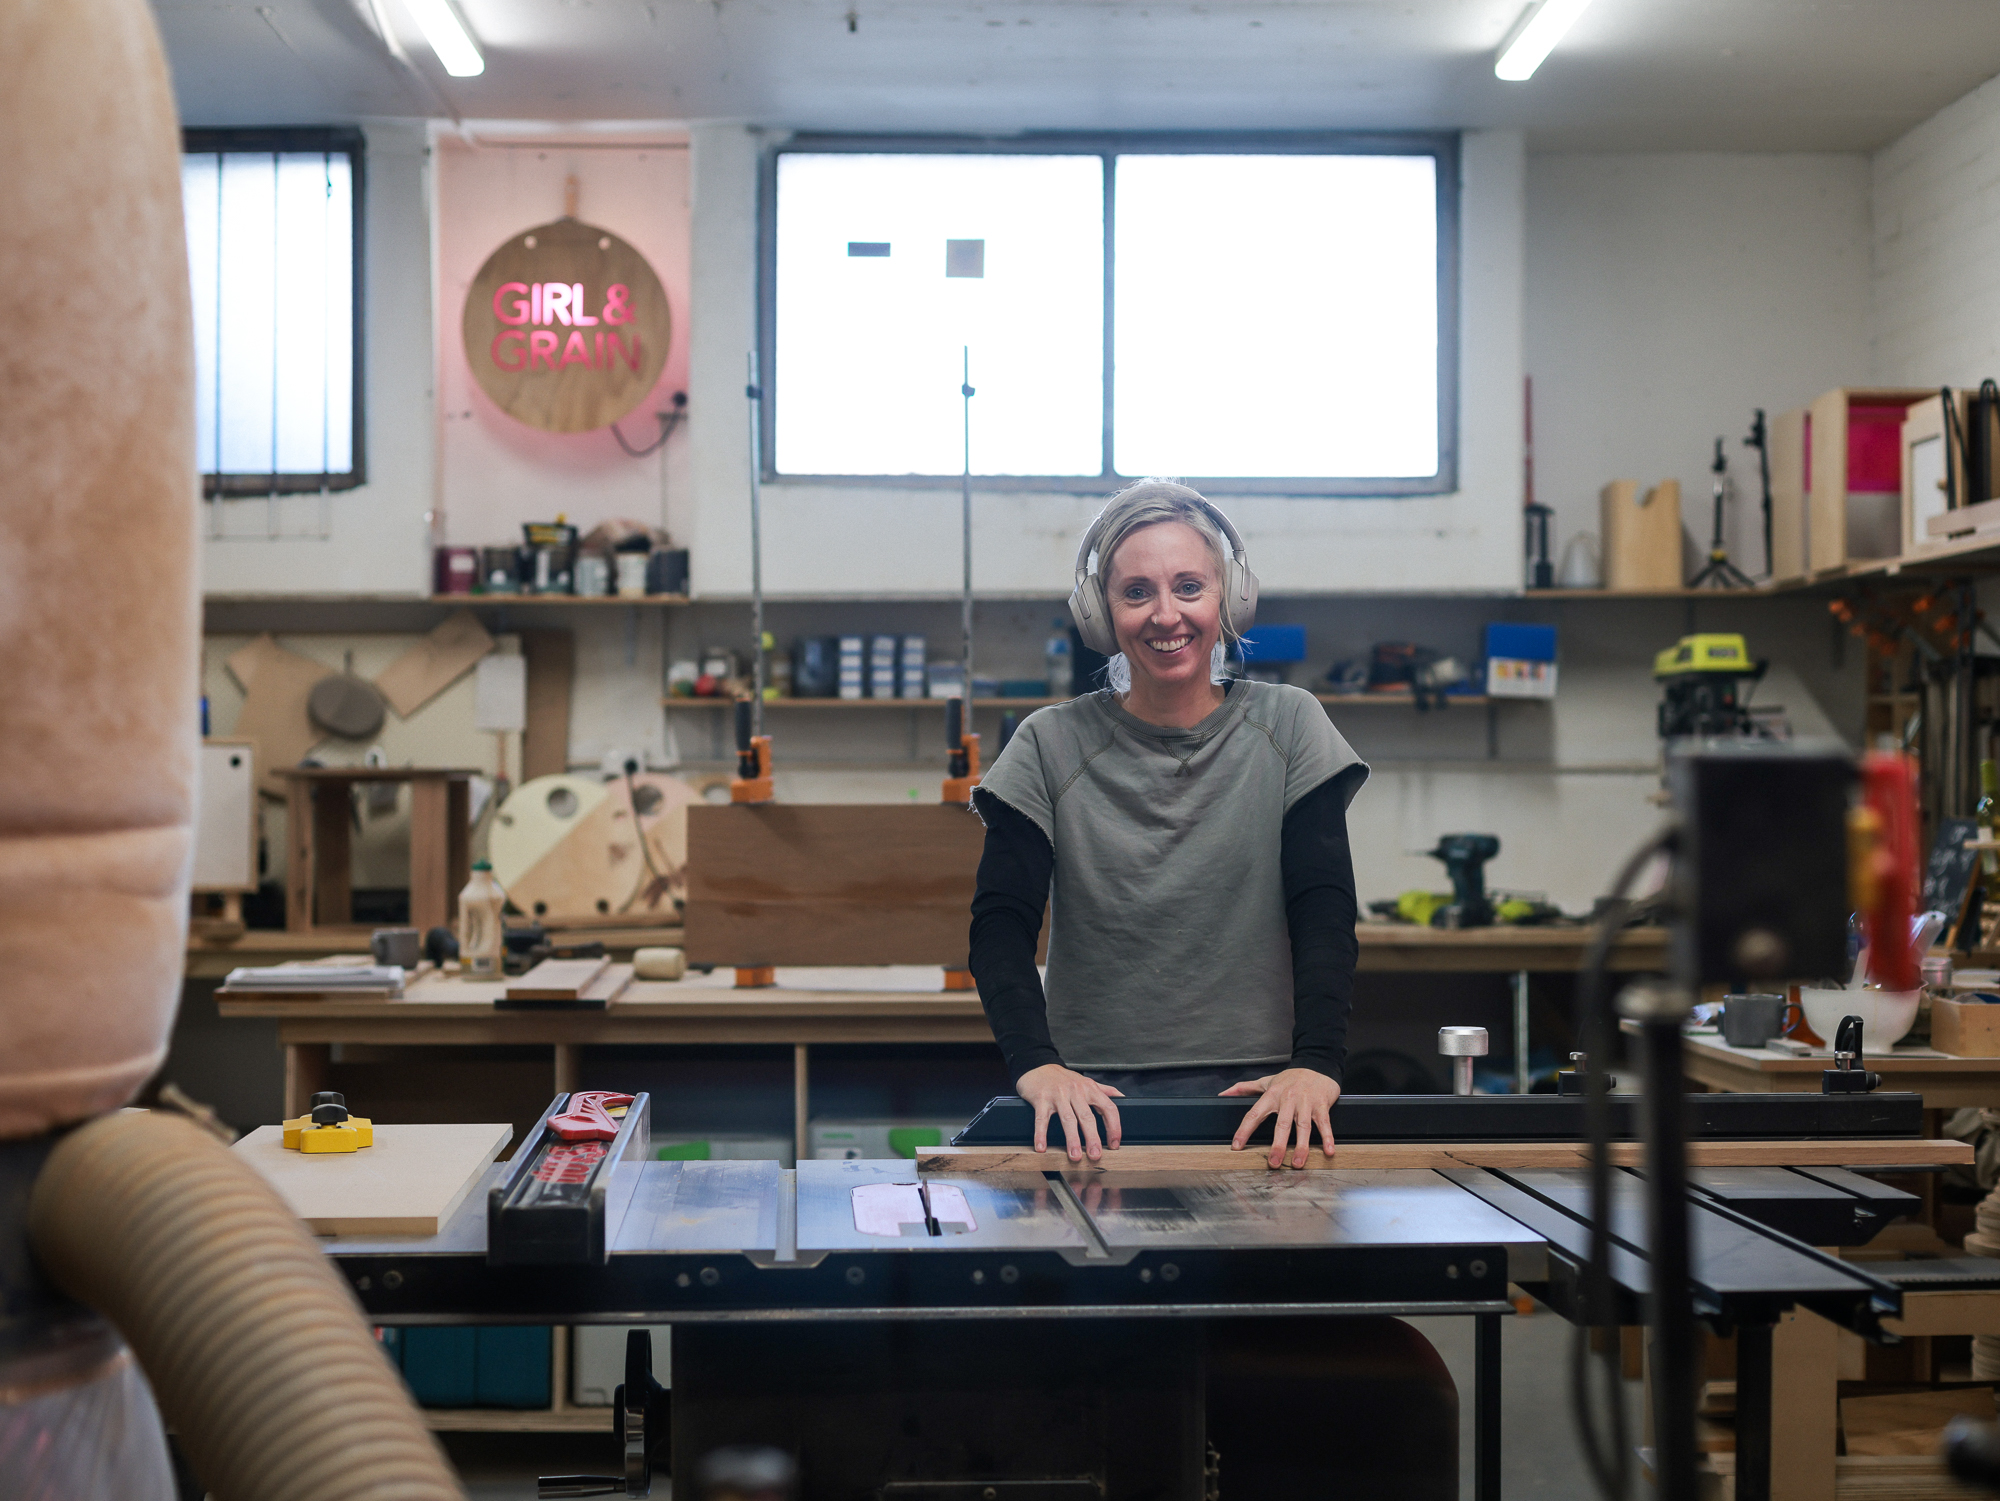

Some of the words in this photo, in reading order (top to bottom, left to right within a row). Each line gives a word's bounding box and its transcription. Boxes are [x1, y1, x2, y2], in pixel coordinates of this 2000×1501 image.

[493, 282, 599, 326] GIRL
[602, 283, 637, 326] &
[490, 330, 642, 373] GRAIN
